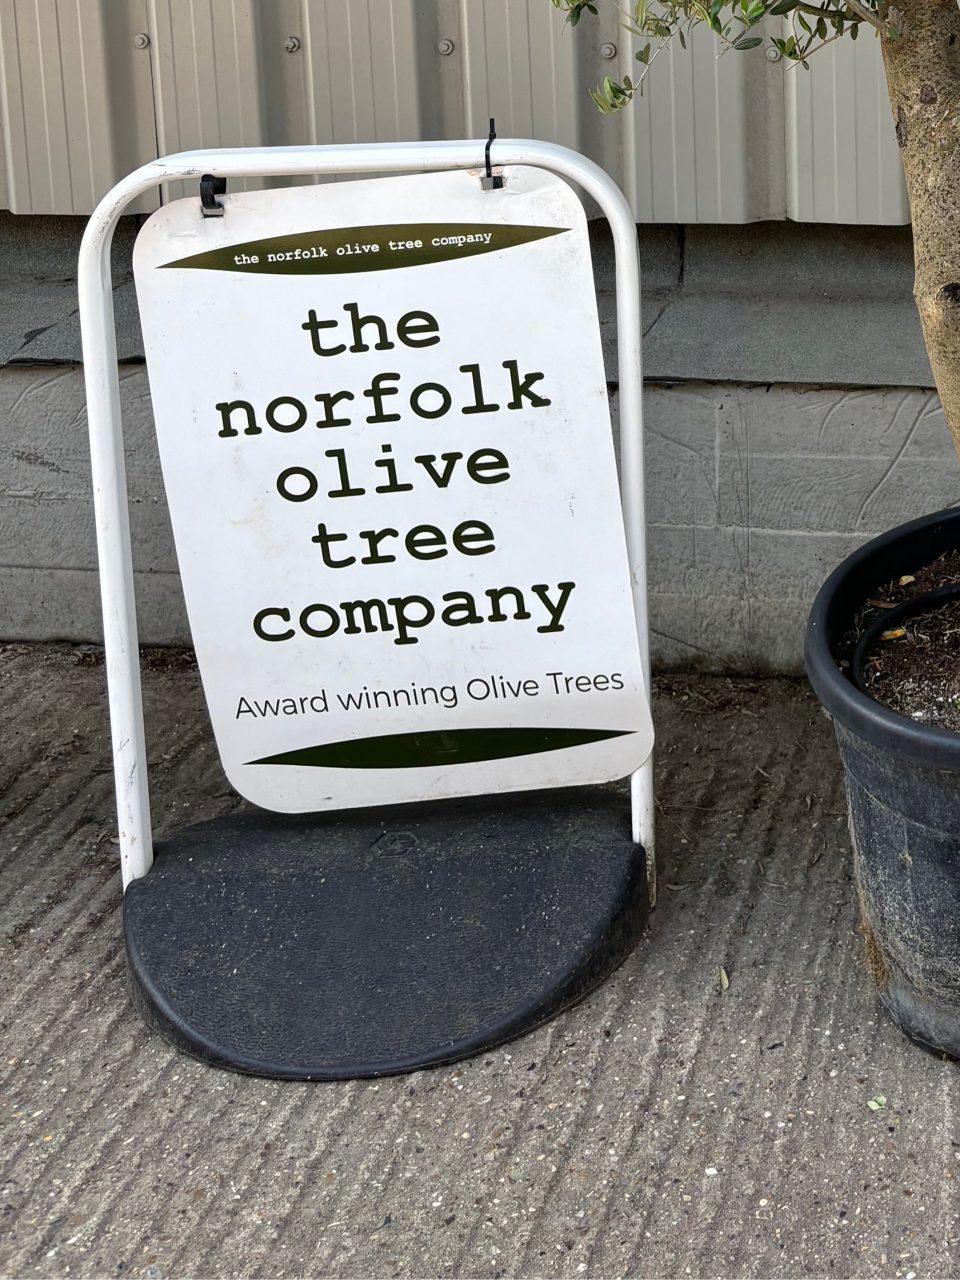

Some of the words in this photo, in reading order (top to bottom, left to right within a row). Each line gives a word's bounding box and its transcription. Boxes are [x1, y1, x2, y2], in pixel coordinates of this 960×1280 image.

[233, 253, 260, 266] the
[267, 247, 329, 263] norfolk
[336, 243, 380, 256] olive
[388, 239, 423, 251] tree
[431, 232, 493, 248] company
[302, 303, 440, 356] the
[216, 359, 551, 437] norfolk
[277, 444, 510, 502] olive
[312, 520, 495, 568] tree
[254, 582, 575, 645] company
[235, 689, 329, 720] Award
[337, 682, 458, 710] winning
[466, 675, 540, 701] Olive
[545, 671, 625, 695] Trees
